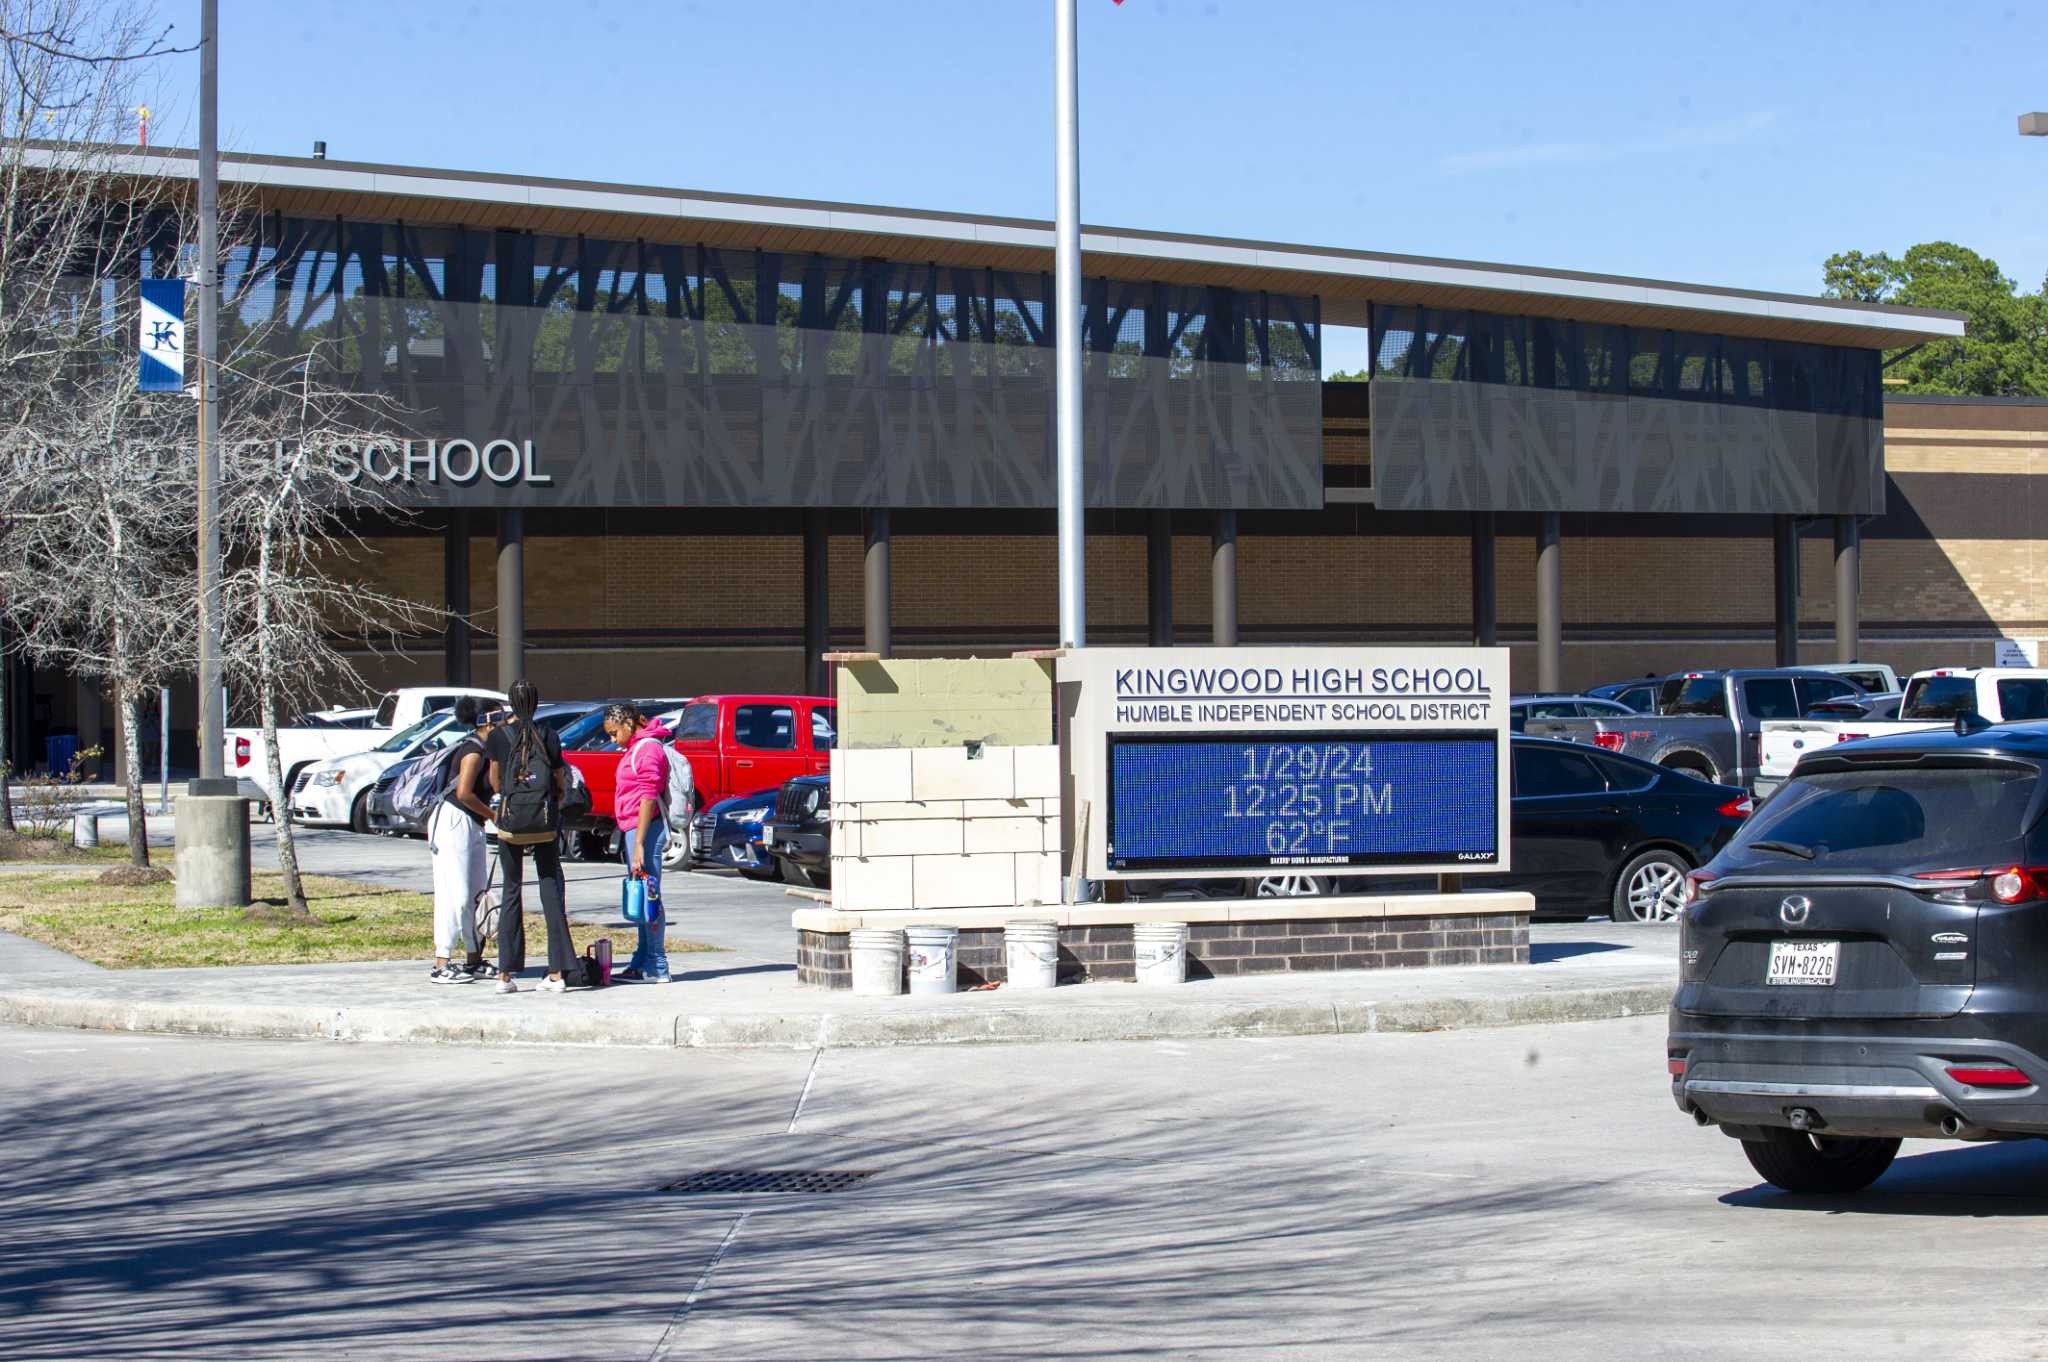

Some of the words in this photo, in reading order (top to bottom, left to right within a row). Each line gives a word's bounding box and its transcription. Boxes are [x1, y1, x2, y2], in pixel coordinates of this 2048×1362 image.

[331, 438, 551, 482] SCHOOL
[1116, 668, 1283, 693] KINGWOOD
[1292, 668, 1363, 693] HIGH
[1372, 668, 1491, 692] SCHOOL
[1116, 705, 1192, 722] HUMBLE
[1199, 704, 1326, 721] INDEPENDENT
[1331, 704, 1406, 720] SCHOOL
[1410, 703, 1491, 720] DISTRICT
[1243, 745, 1374, 780] 1/29/24
[1224, 784, 1322, 816] 12:25
[1335, 783, 1393, 815] PM
[1266, 820, 1352, 854] 62°F
[1458, 852, 1494, 860] GALAXY
[1793, 943, 1818, 951] TEXAS
